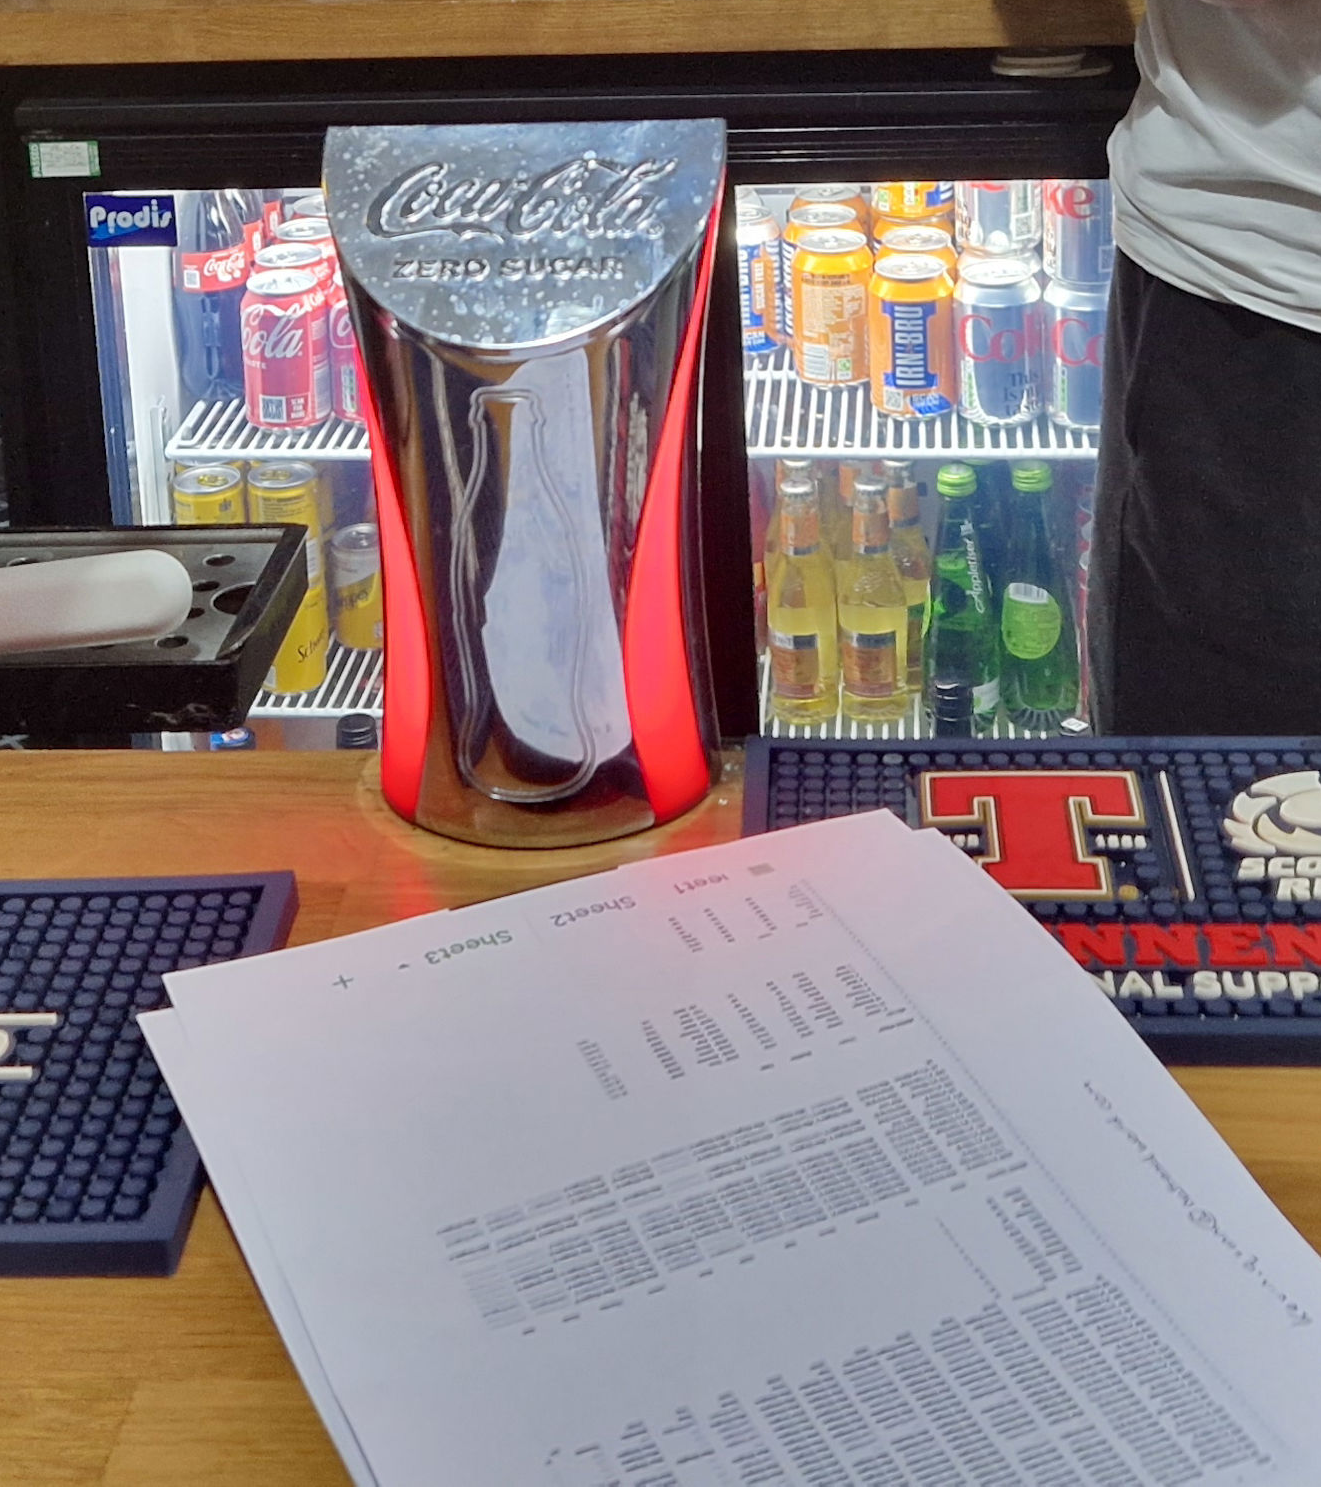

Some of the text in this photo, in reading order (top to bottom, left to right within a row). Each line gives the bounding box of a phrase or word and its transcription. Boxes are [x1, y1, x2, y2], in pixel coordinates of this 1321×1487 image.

[89, 199, 172, 234] Prodis
[367, 157, 678, 244] Coca-Cola
[393, 256, 626, 280] ZERO SUGAR
[966, 537, 985, 614] Appletiser
[922, 771, 1145, 900] T
[549, 895, 637, 928] Sheet2
[424, 929, 514, 966] Sheet3
